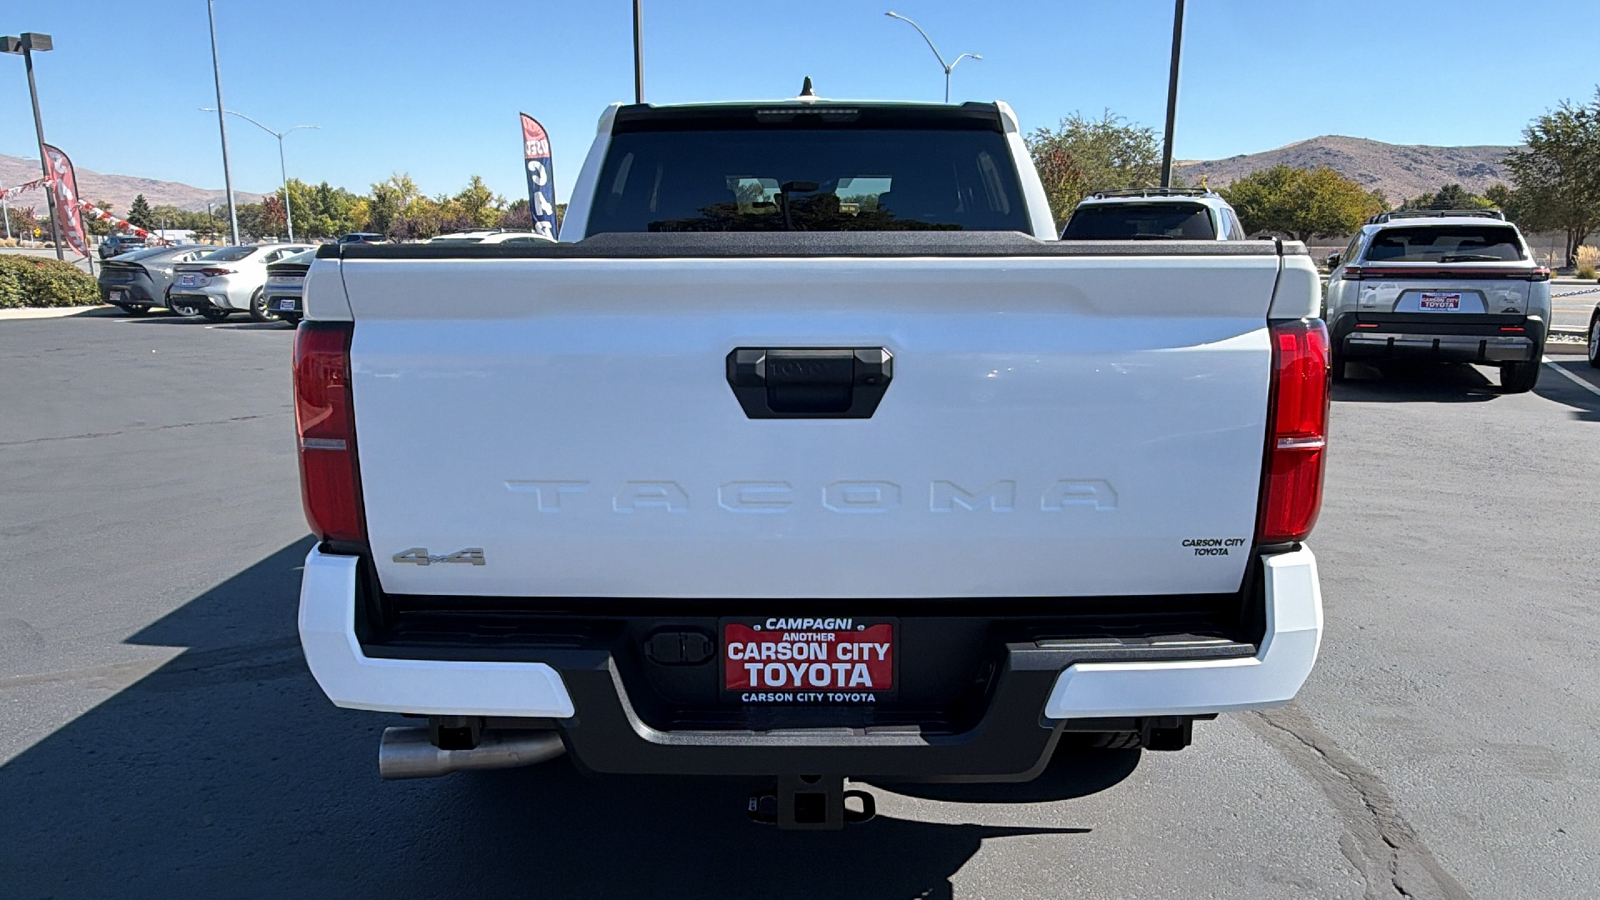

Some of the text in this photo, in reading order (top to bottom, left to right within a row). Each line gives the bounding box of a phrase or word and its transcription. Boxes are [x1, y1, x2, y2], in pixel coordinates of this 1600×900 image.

[504, 479, 1120, 514] TACOMA
[1182, 538, 1246, 547] CARSON CITY
[1194, 548, 1229, 556] TOYOTA
[766, 618, 852, 630] CAMPAGNI
[782, 632, 836, 642] ANOTHER
[727, 642, 891, 661] CARSON CITY
[744, 662, 873, 687] TOYOTA
[741, 693, 876, 702] CARSON CITY TOYOTA
